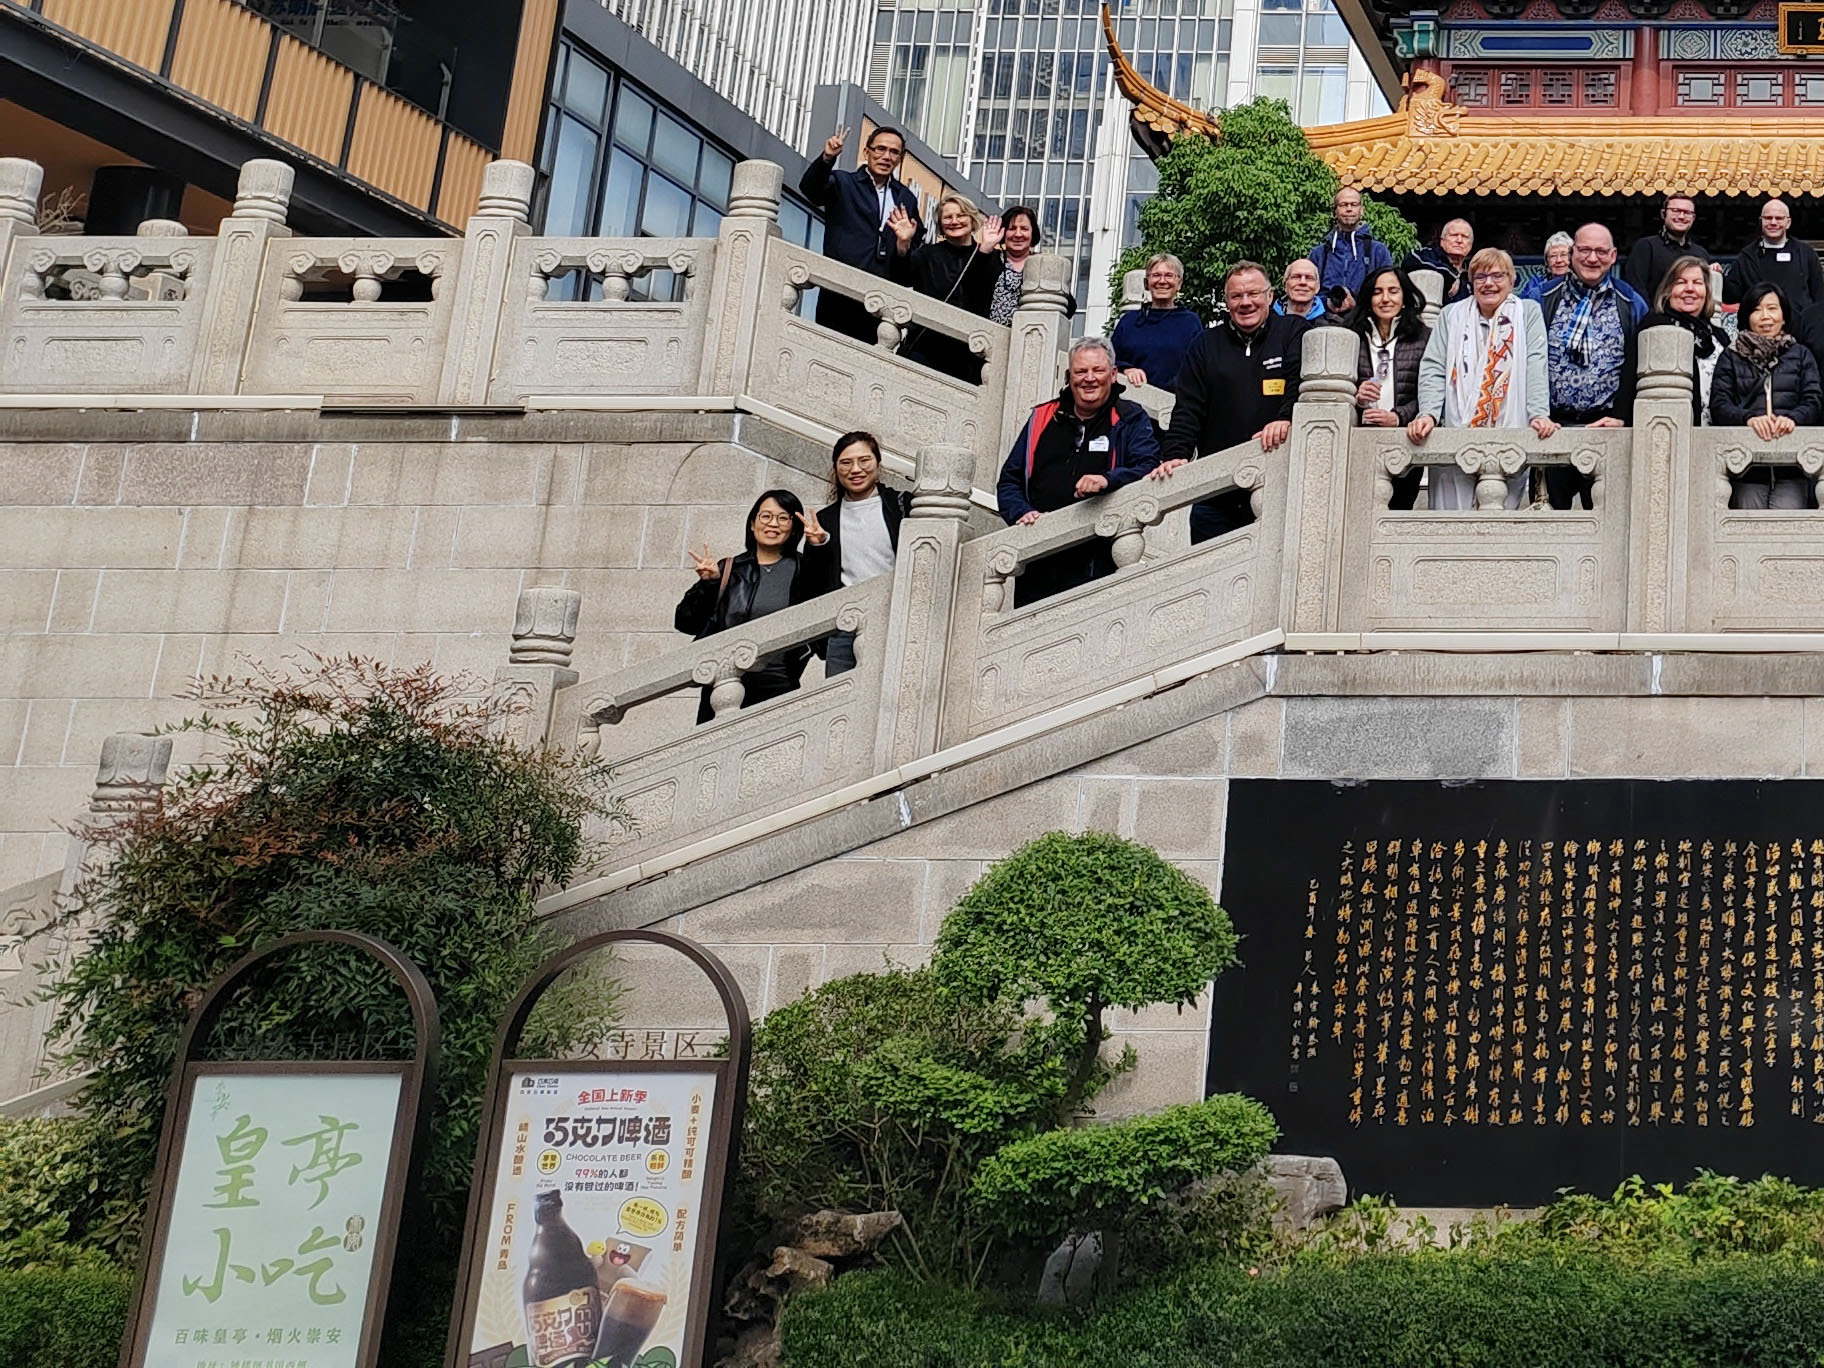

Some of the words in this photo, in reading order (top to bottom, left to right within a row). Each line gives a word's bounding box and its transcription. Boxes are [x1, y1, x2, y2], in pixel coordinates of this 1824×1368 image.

[577, 1088, 648, 1105] 全国上新季
[543, 1114, 672, 1149] 巧克力啤酒
[202, 1114, 363, 1210] 皇亭
[565, 1153, 618, 1163] CHOCOLATE
[620, 1153, 643, 1162] BEER
[501, 1203, 517, 1246] FROM
[182, 1226, 347, 1306] 小吃
